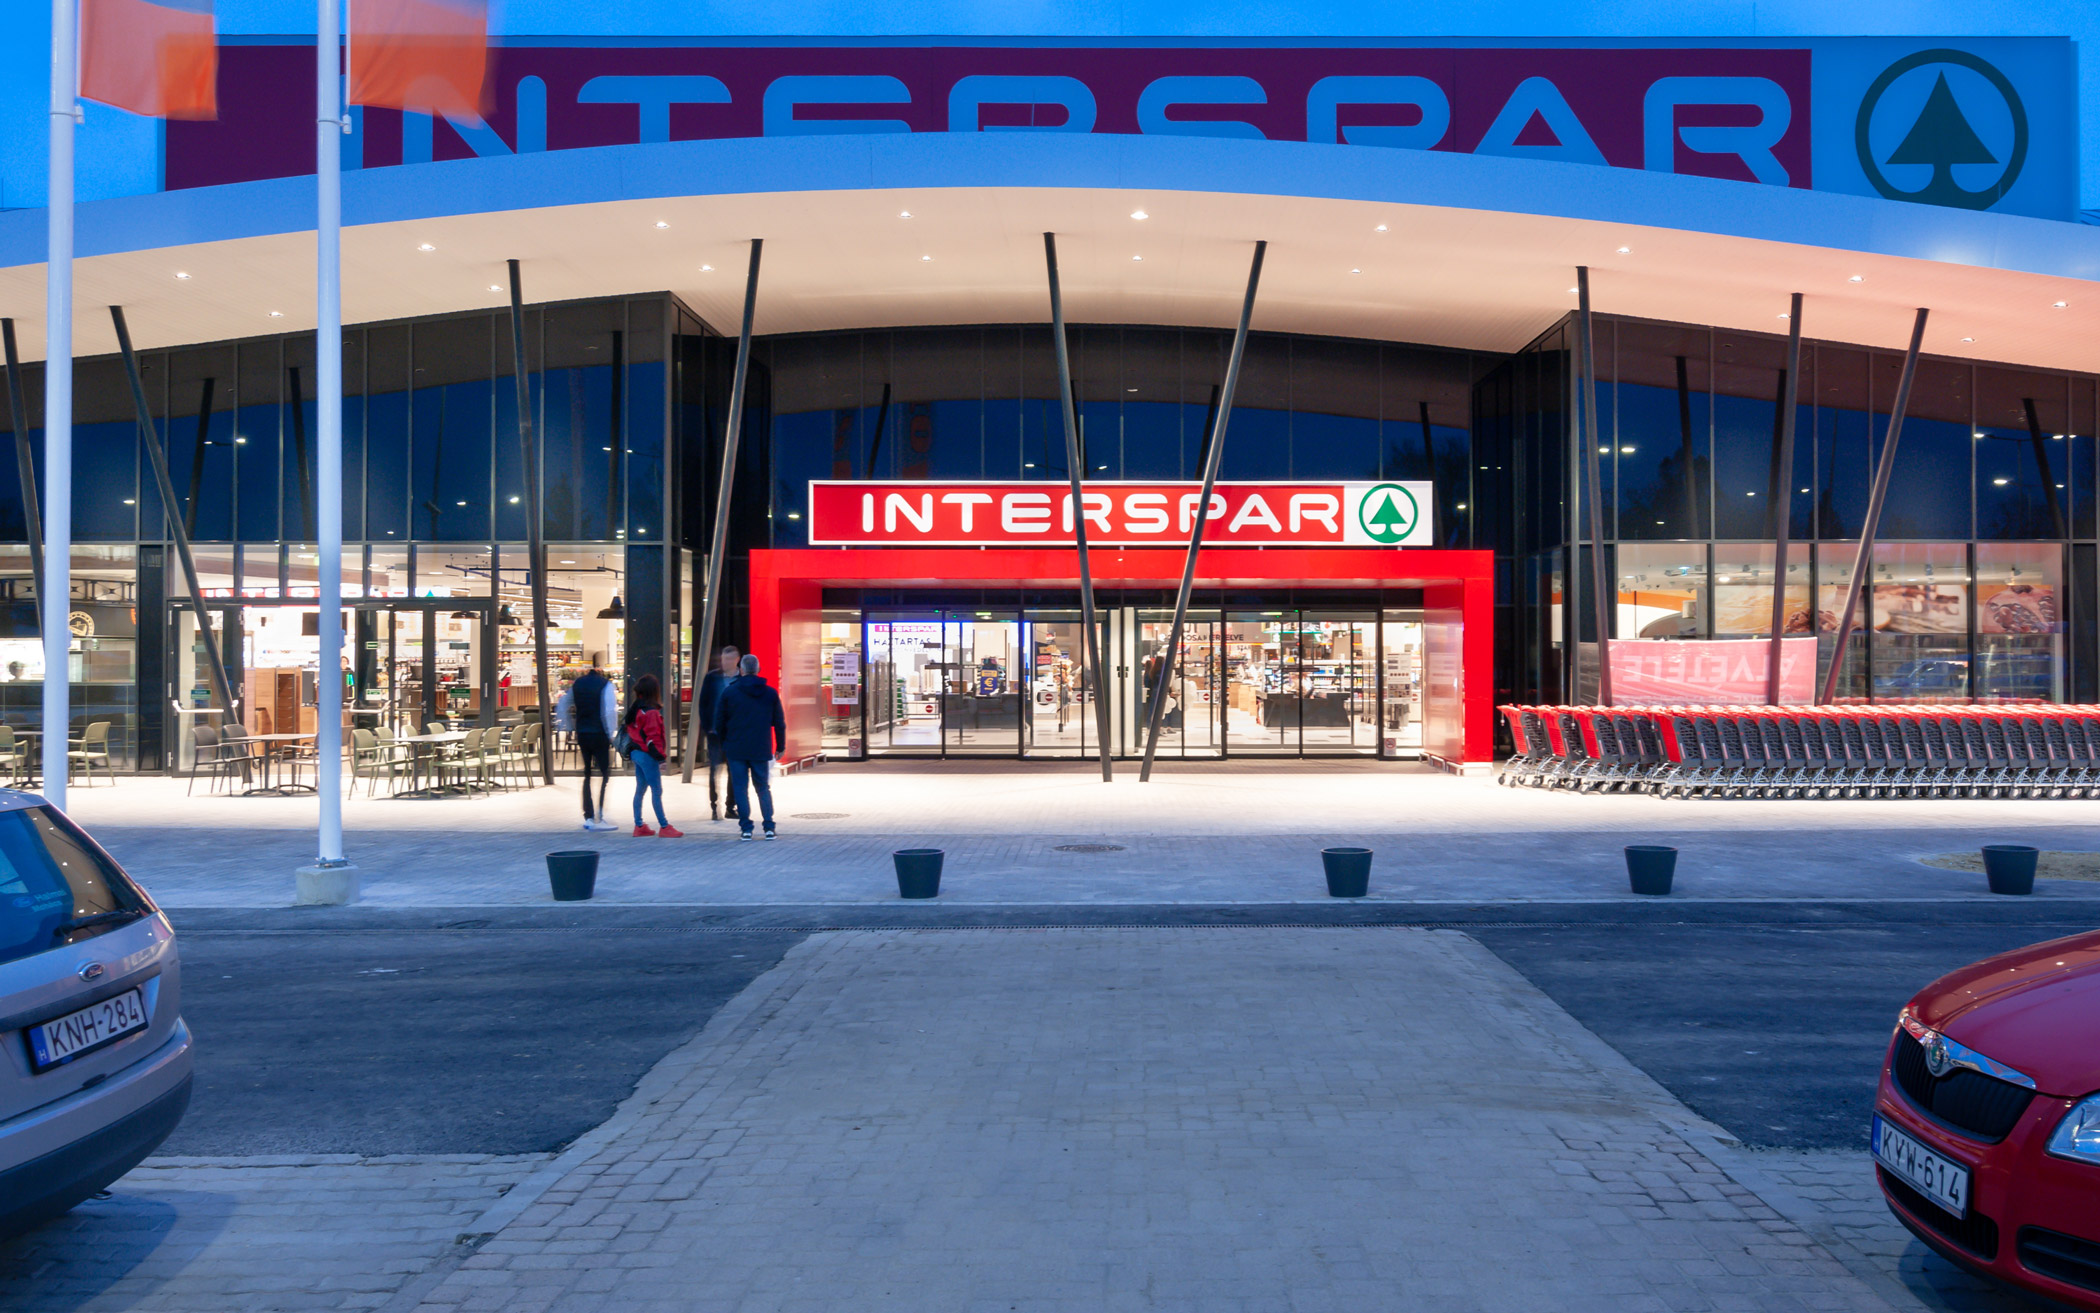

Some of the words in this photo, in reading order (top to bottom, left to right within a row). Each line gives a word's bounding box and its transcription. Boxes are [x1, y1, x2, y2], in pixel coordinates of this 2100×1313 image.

[862, 492, 1340, 534] INTERSPAR
[49, 995, 139, 1056] KNH-284
[1883, 1127, 1959, 1204] KYW-614
